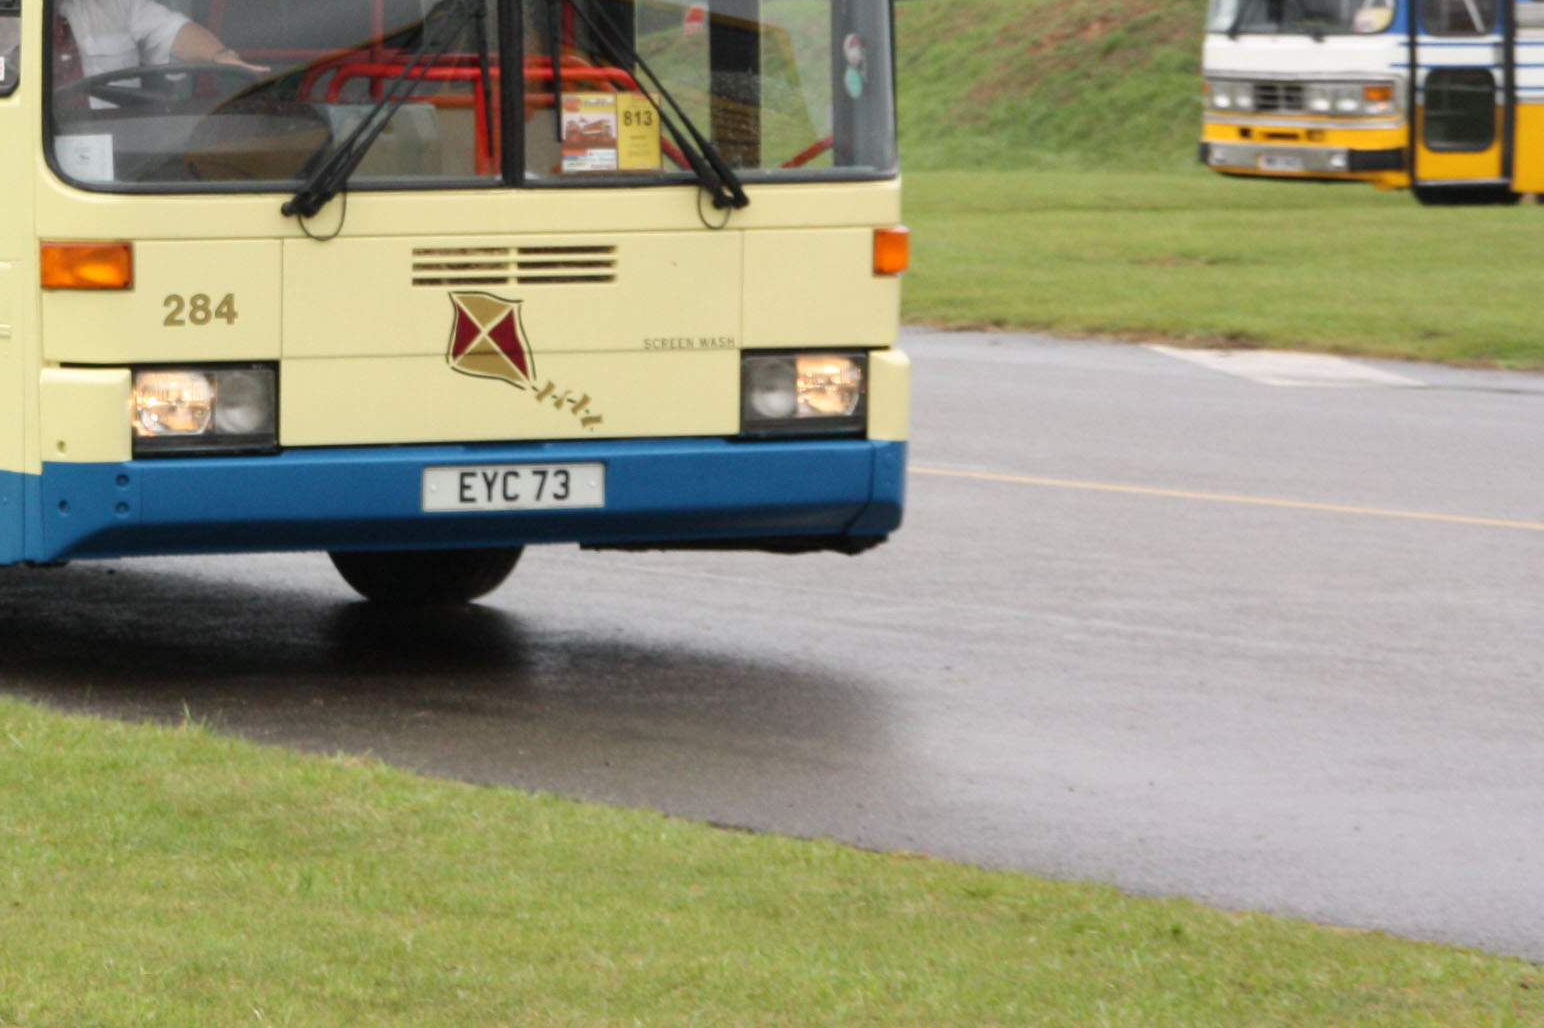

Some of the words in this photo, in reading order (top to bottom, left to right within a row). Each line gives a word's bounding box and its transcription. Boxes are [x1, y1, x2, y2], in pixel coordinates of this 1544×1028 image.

[623, 109, 654, 127] 813
[162, 292, 239, 327] 284
[643, 337, 694, 351] SCREEN
[698, 336, 736, 349] WASH
[458, 470, 521, 504] EYC
[533, 468, 572, 502] 73
